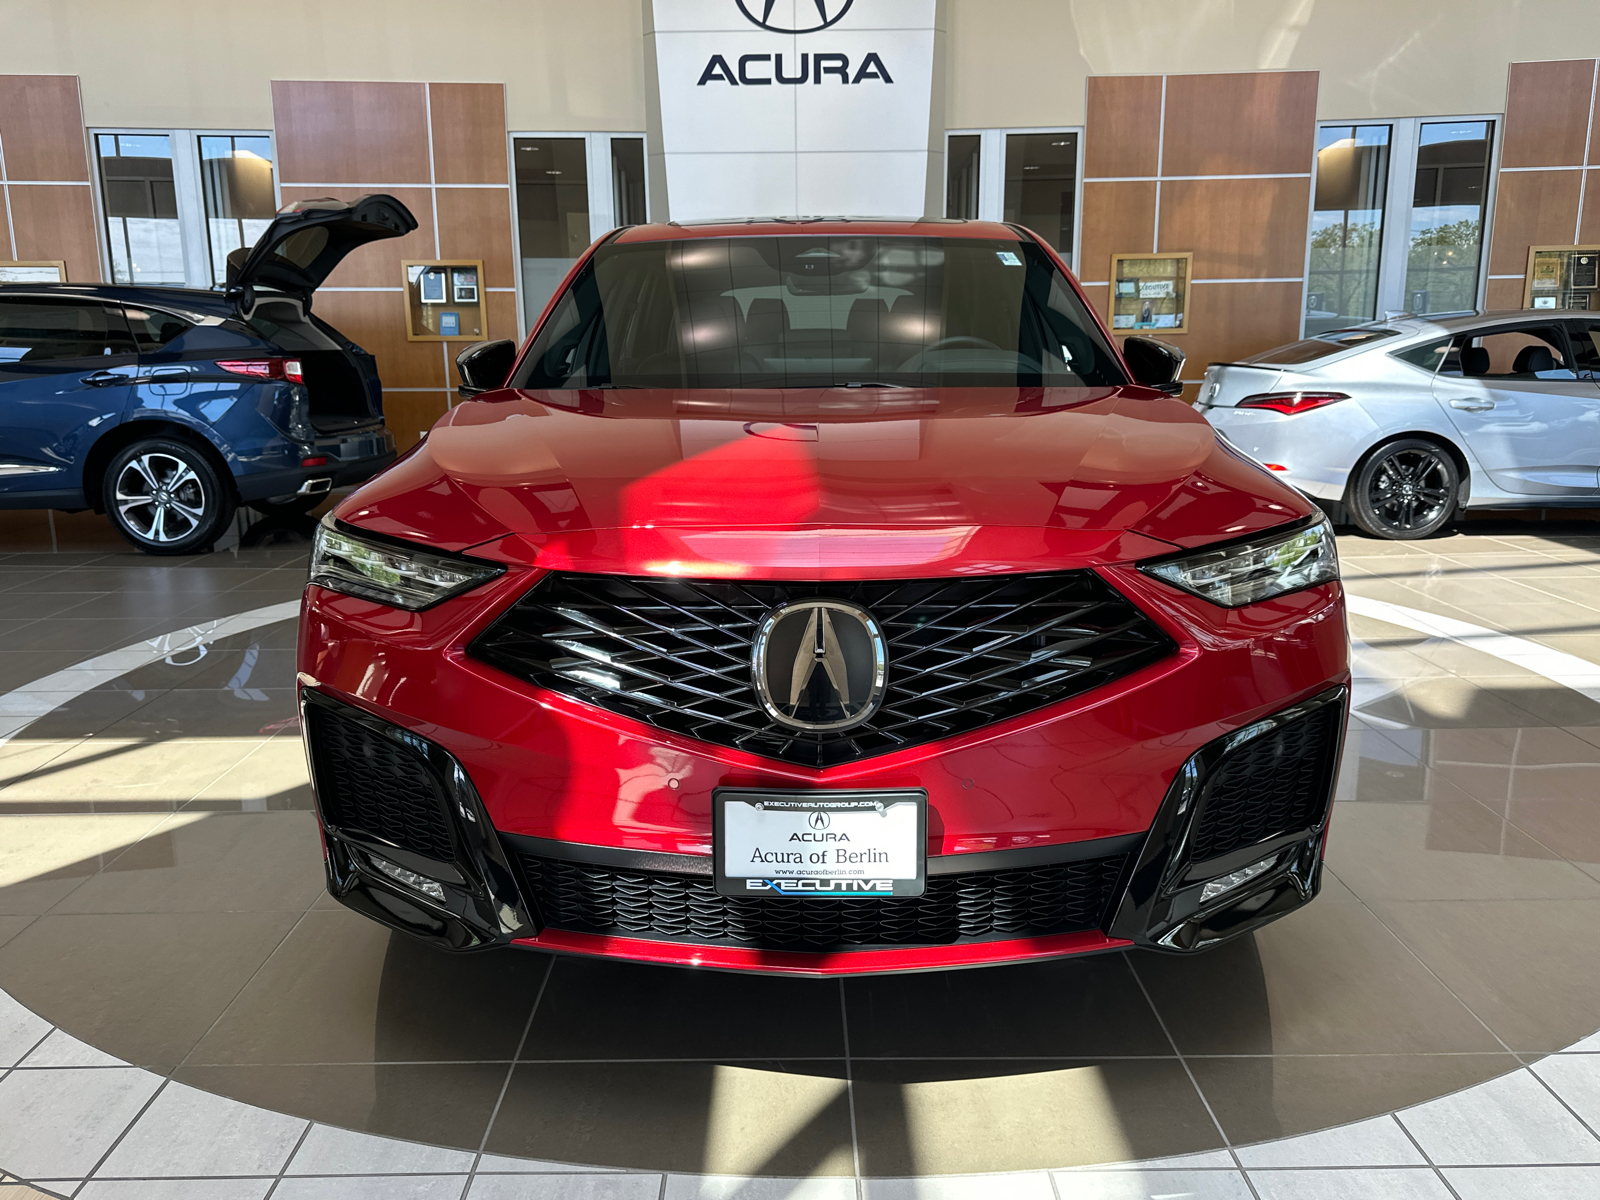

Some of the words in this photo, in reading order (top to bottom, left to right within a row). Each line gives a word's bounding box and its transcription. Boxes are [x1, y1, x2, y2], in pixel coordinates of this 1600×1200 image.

[697, 52, 894, 86] ACURA
[789, 833, 850, 842] ACURA
[750, 847, 803, 864] Acura
[809, 850, 828, 864] of
[835, 848, 889, 864] Berlin
[746, 879, 893, 891] EXECUTIVE
